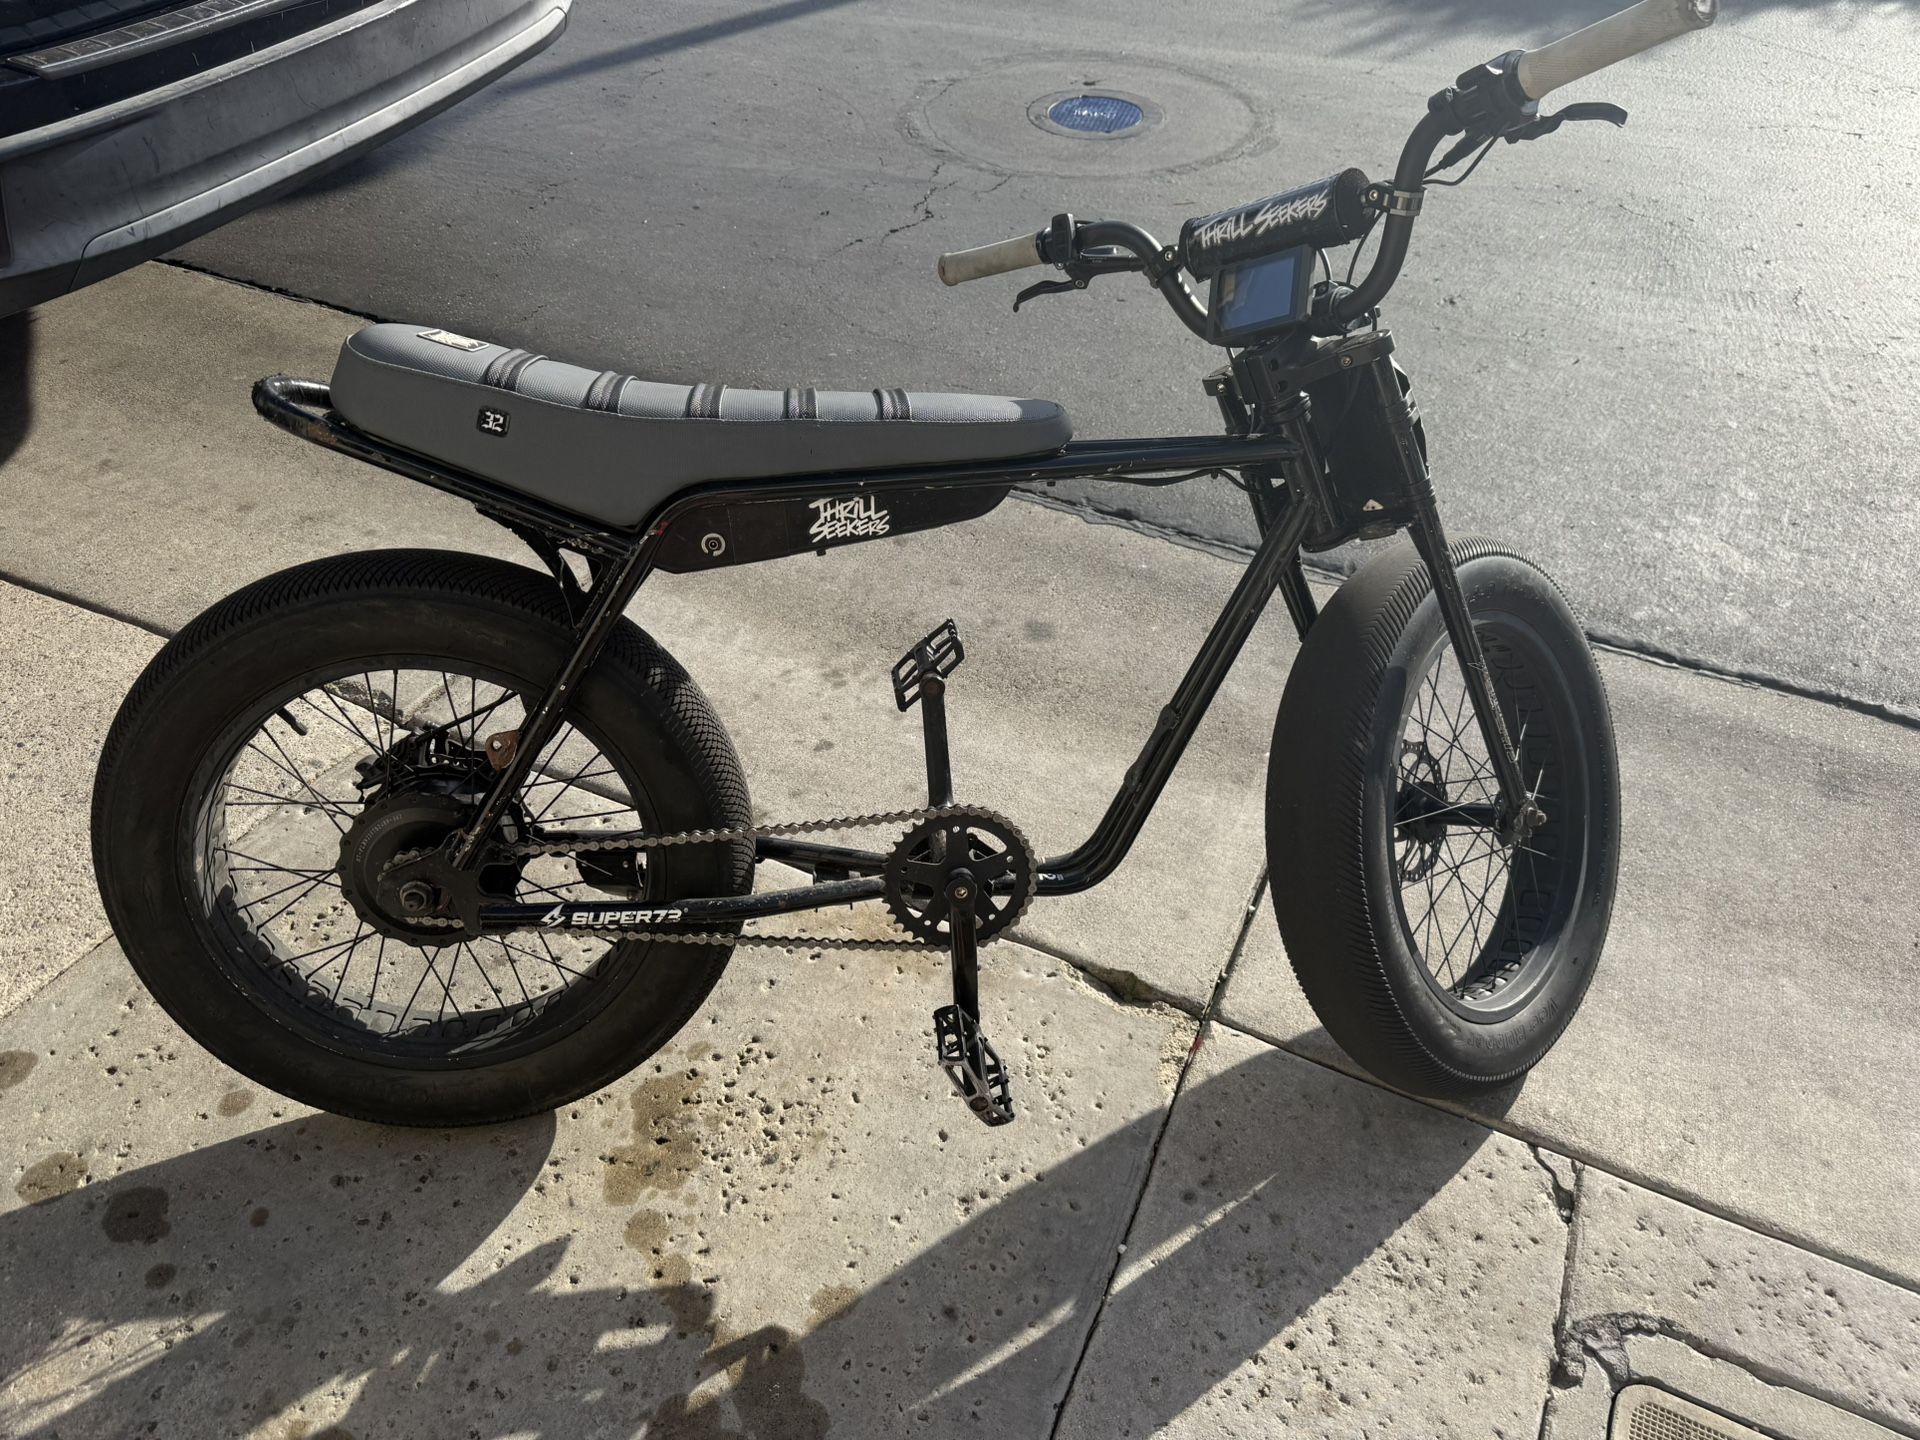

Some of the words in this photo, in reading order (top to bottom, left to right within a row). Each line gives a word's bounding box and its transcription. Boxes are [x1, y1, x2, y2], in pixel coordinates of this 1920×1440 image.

[1194, 213, 1253, 248] THRILL
[1253, 189, 1328, 236] SEEKERS
[481, 411, 505, 432] 32
[808, 495, 888, 523] THRILL
[808, 515, 890, 543] SEEKERS
[571, 909, 683, 925] SUPER73
